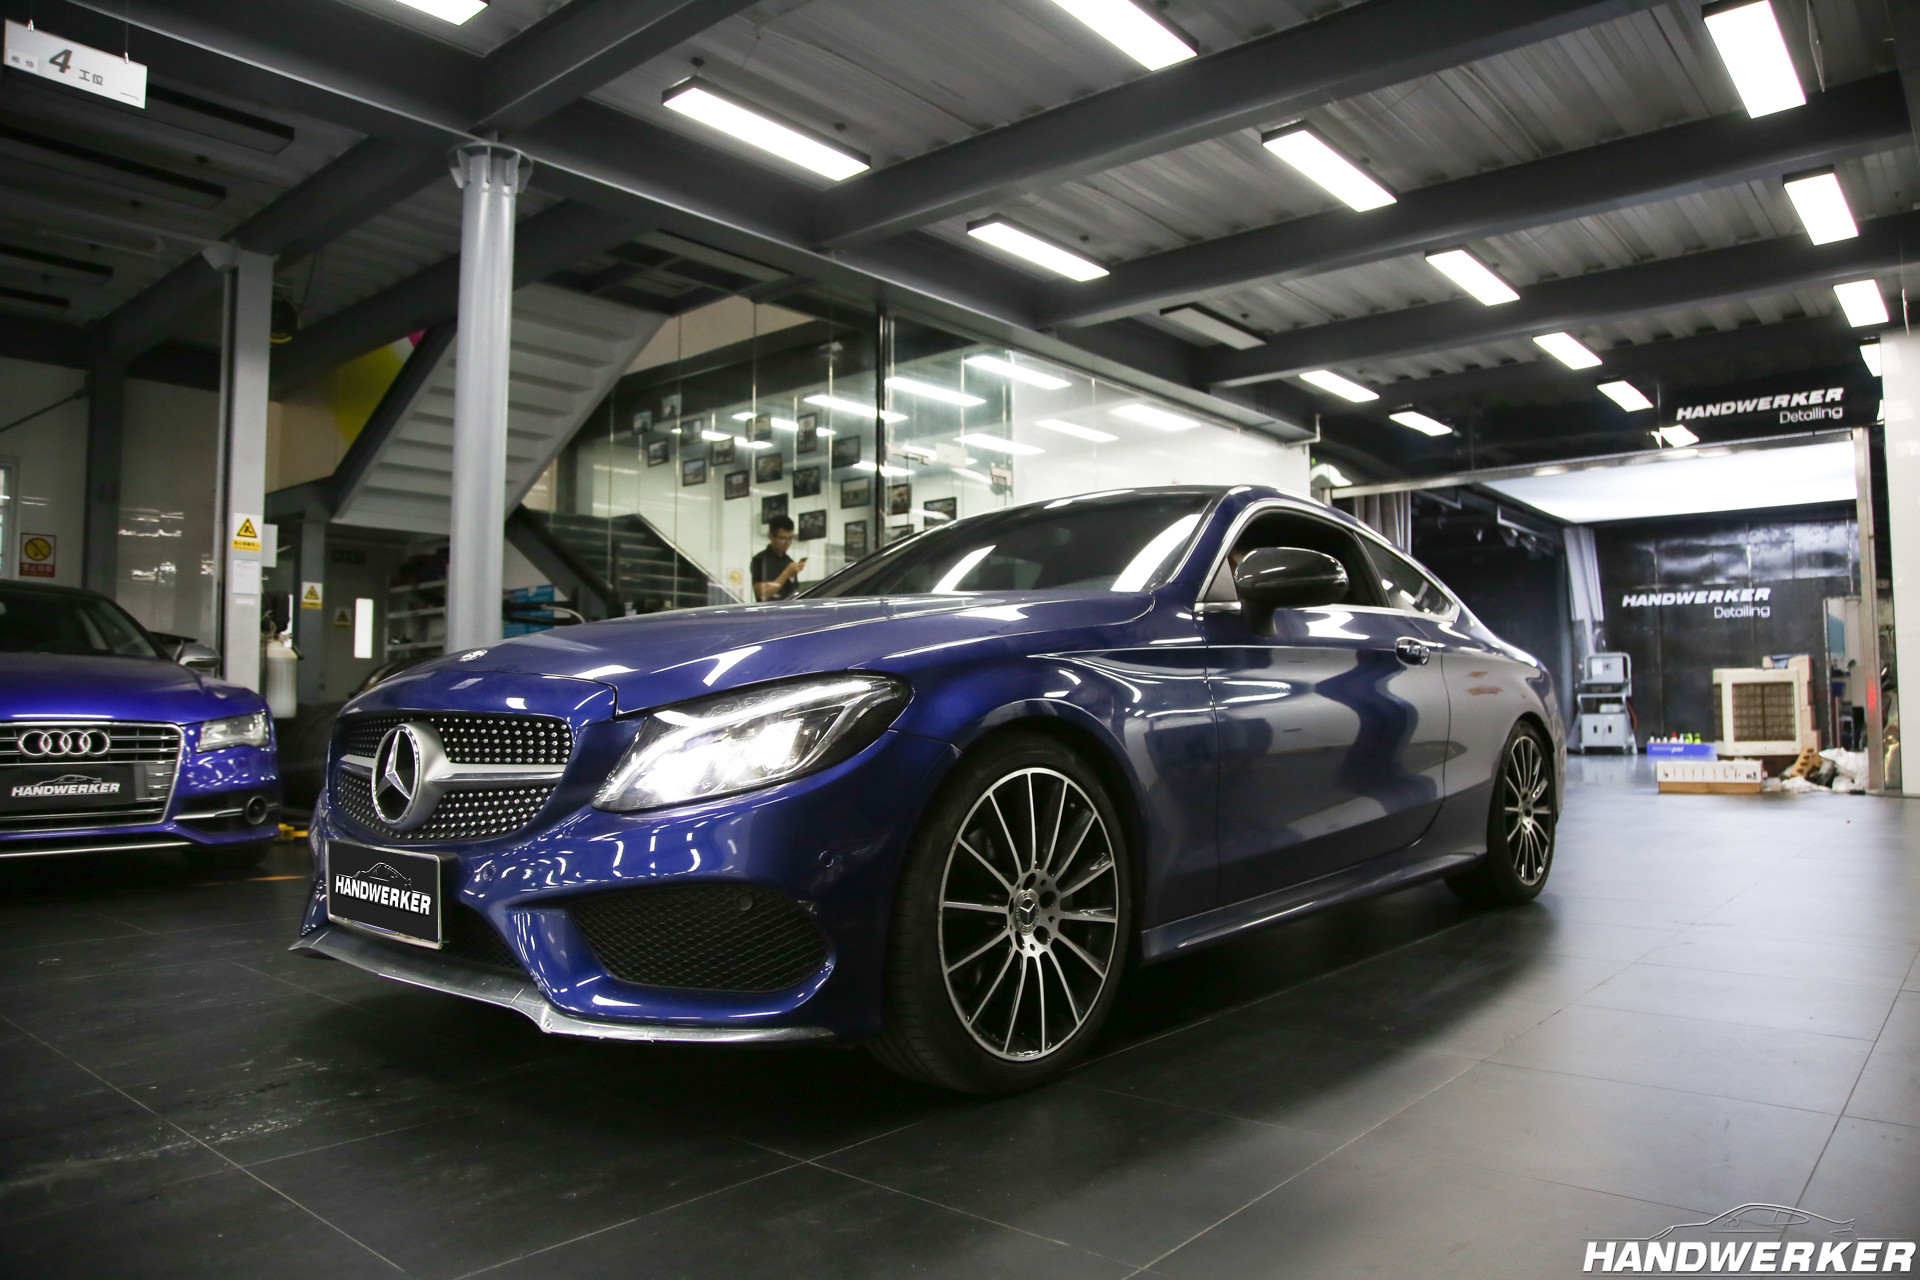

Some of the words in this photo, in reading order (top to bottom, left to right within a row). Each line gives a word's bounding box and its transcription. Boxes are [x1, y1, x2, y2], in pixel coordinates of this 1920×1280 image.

[49, 49, 73, 74] 4
[78, 69, 104, 86] 工位
[1676, 387, 1844, 421] HANDWERKER
[1779, 407, 1843, 424] Detailing
[1622, 587, 1771, 608] HANDWERKER
[1714, 604, 1771, 619] Detailing
[11, 781, 121, 797] HANDWERKER
[335, 875, 432, 915] HANDWERKER
